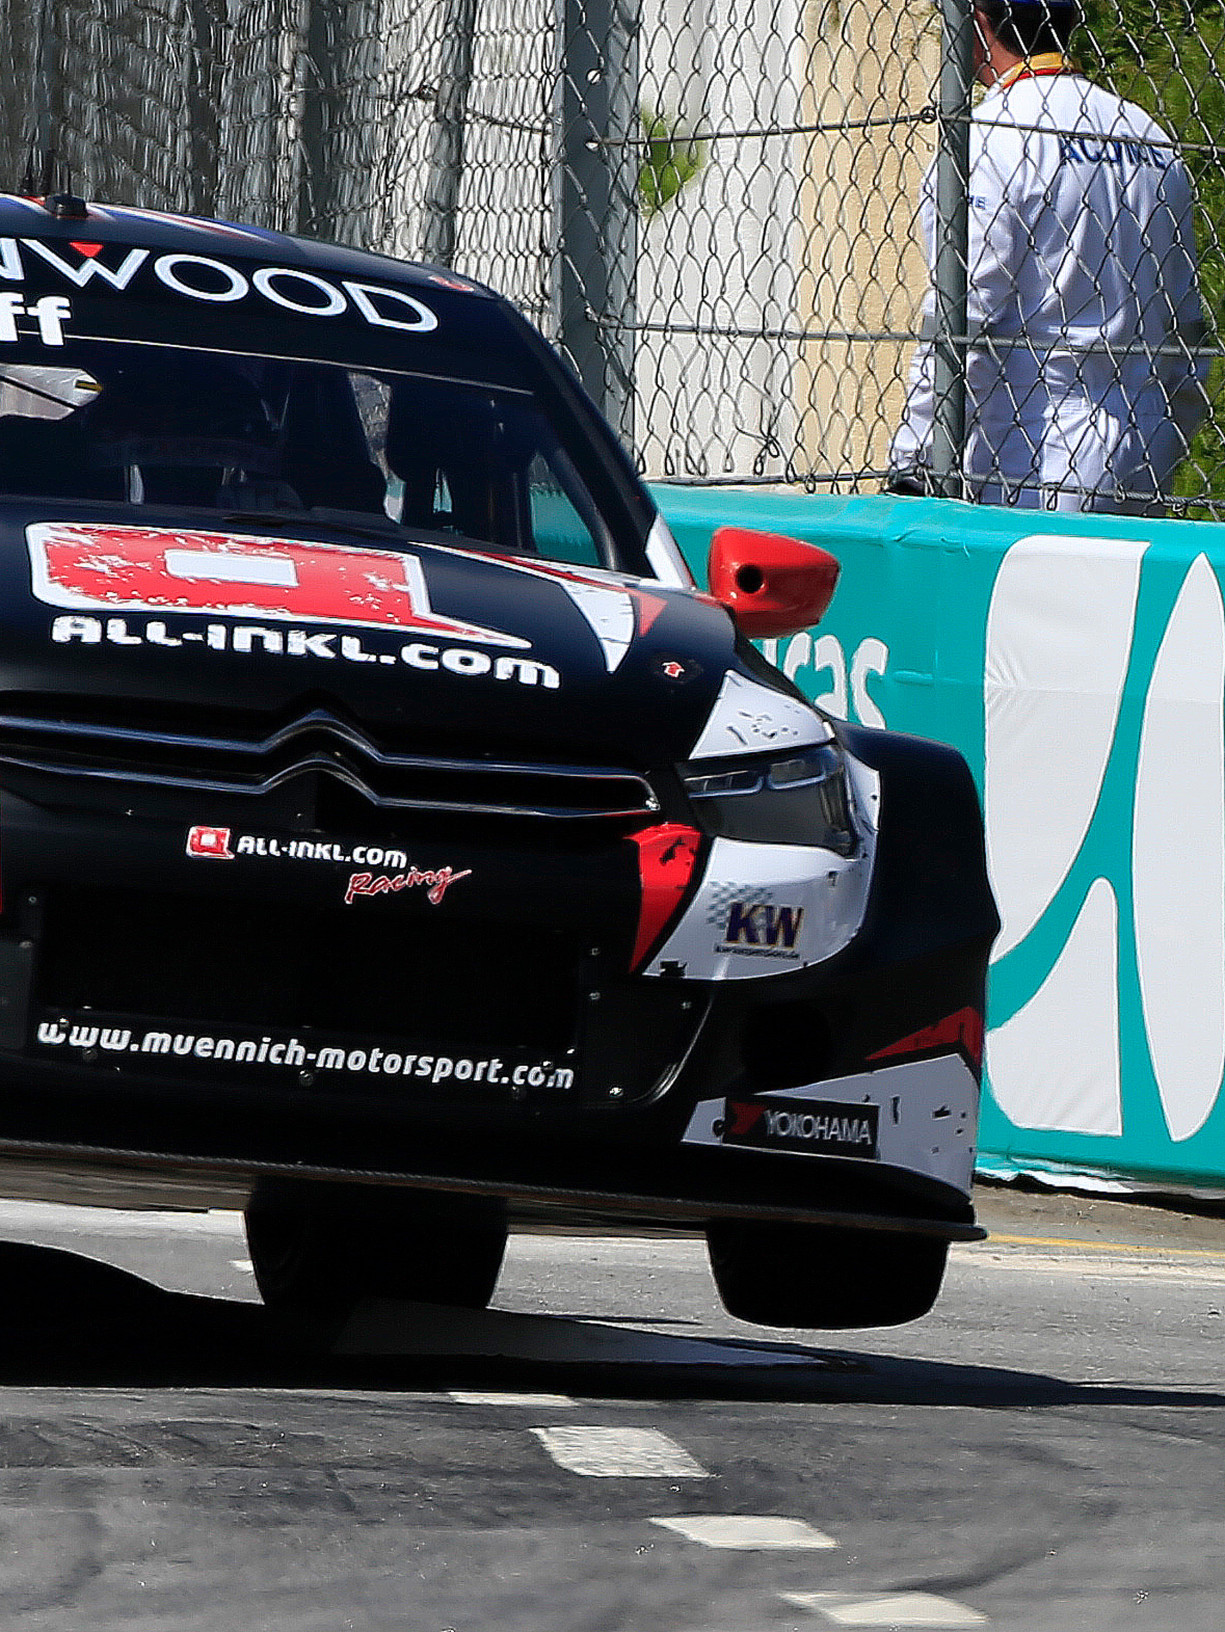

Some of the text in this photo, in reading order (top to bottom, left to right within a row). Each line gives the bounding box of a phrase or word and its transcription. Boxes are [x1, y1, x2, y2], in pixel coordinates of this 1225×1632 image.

[344, 866, 472, 904] Racing
[725, 901, 804, 949] KW
[37, 1020, 575, 1090] www.muennich-motorsport.com
[763, 1108, 873, 1146] YOKOHAMA
